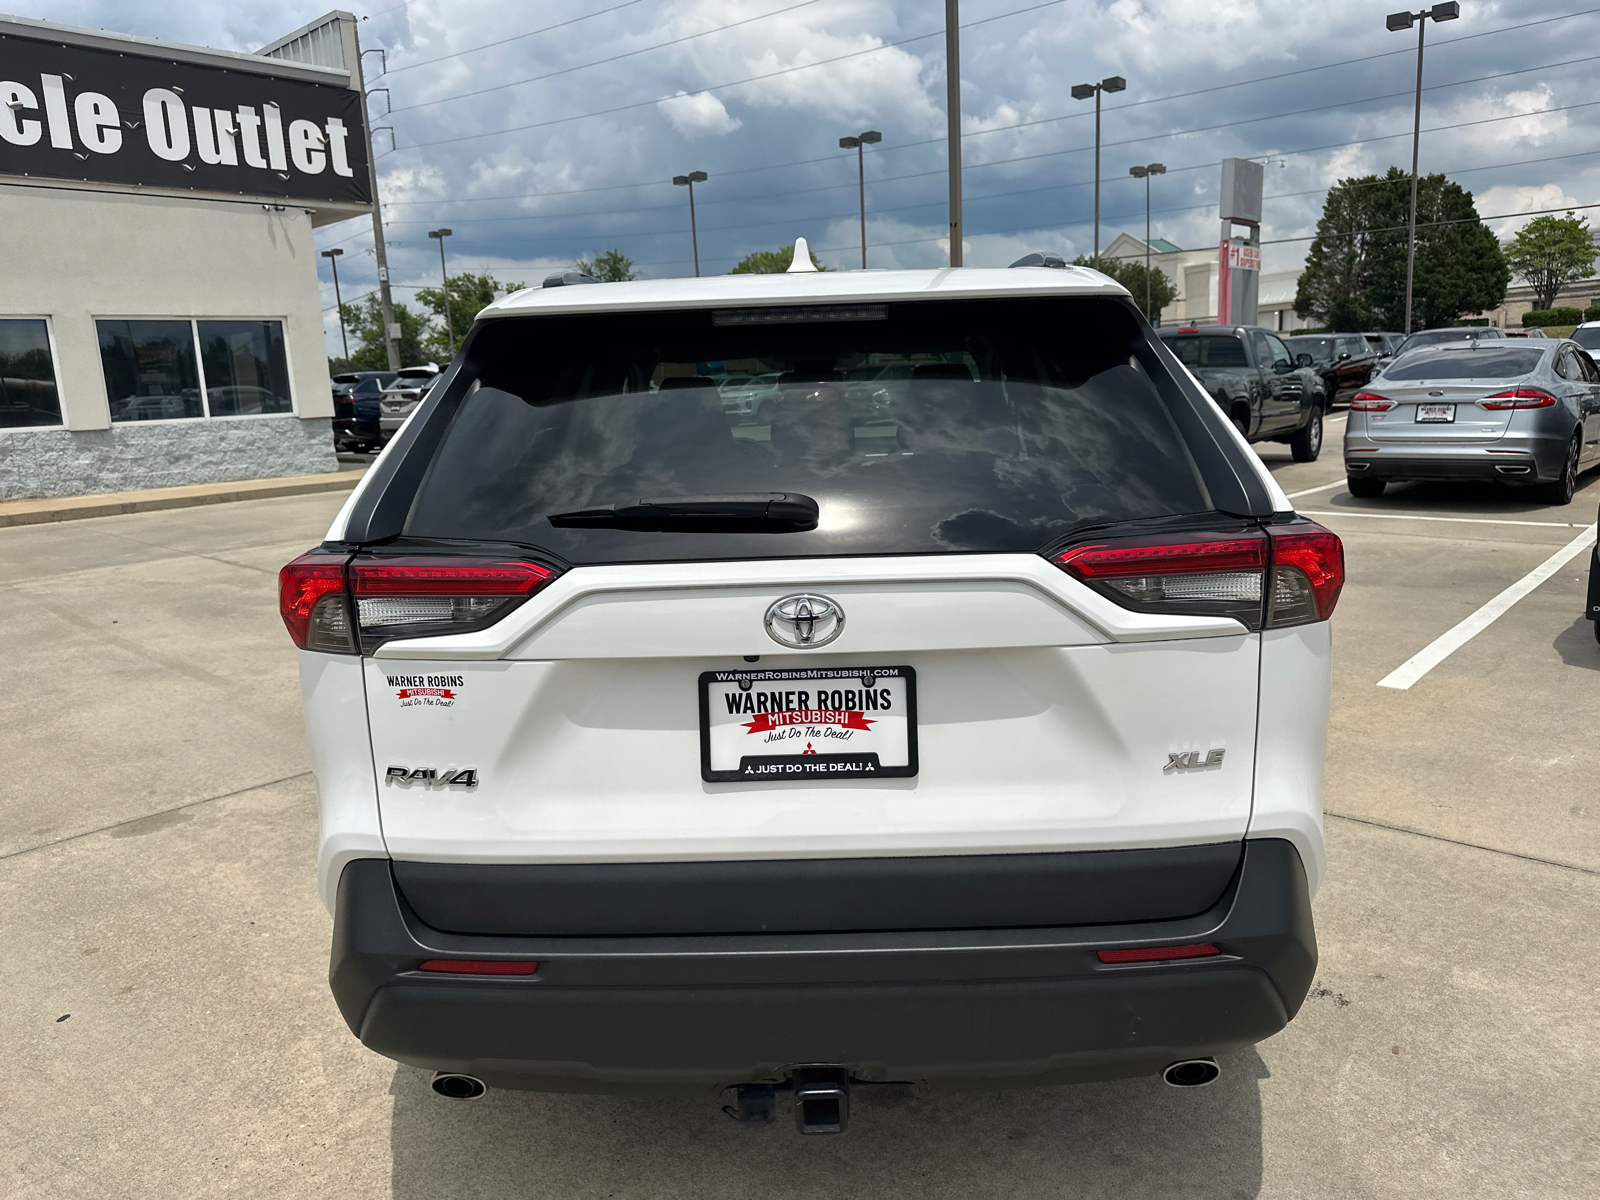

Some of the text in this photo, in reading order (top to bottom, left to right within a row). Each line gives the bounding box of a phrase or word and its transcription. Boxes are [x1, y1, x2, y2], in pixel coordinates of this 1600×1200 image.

[0, 73, 354, 178] cle Outlet
[386, 675, 464, 687] WARNER ROBINS
[406, 688, 445, 696] MITSUBISHI
[400, 699, 414, 708] Just
[413, 698, 422, 706] Do
[423, 697, 434, 706] The
[724, 688, 892, 715] WARNER ROBINS
[767, 711, 849, 726] MITSUBISHI
[764, 725, 854, 743] Just Do The Deal!
[1162, 747, 1226, 771] XLE
[755, 762, 863, 774] JUST DO THE DEAL!
[384, 764, 479, 789] RAV4
